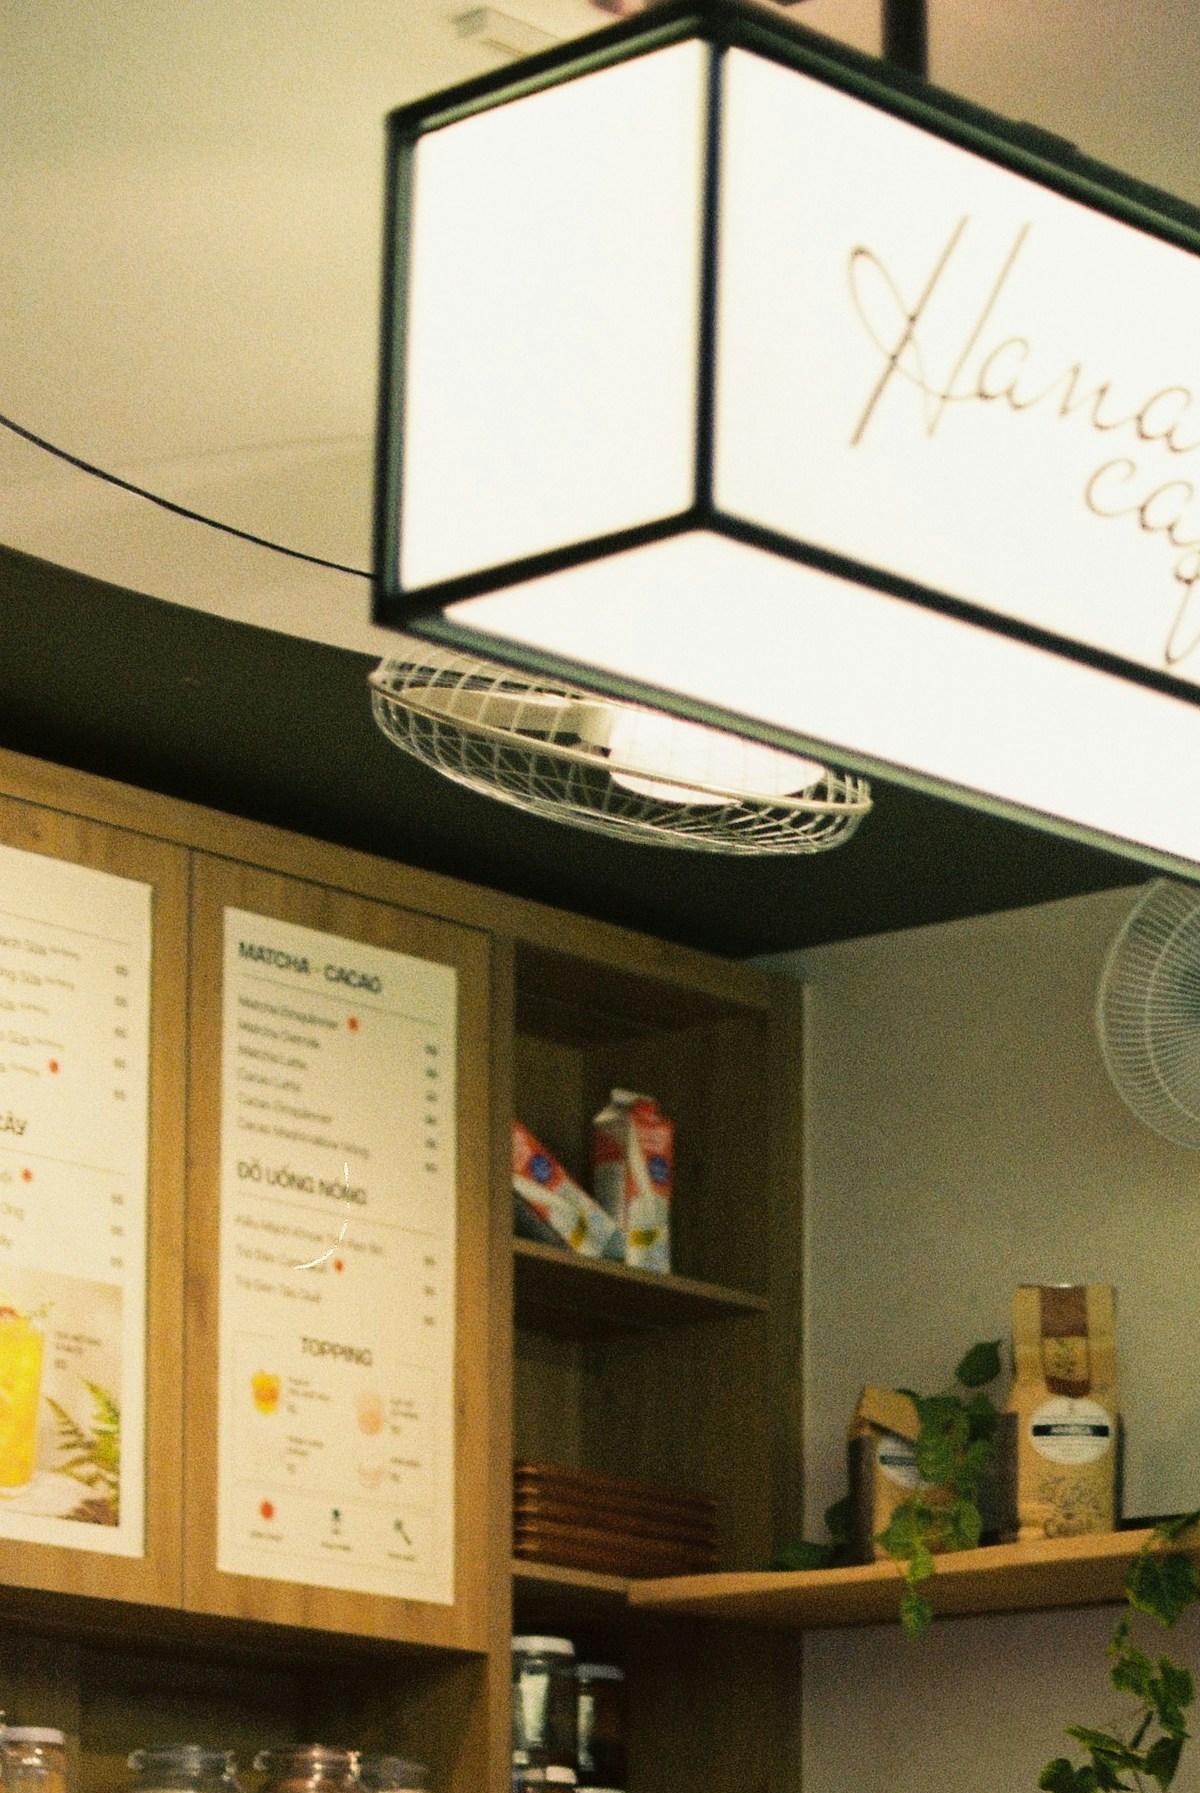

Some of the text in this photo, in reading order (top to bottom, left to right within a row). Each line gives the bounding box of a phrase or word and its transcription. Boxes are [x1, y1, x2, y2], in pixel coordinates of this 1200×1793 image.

[238, 940, 310, 975] MATCHA
[323, 963, 382, 993] CACAO
[301, 1336, 373, 1367] TOPPING
